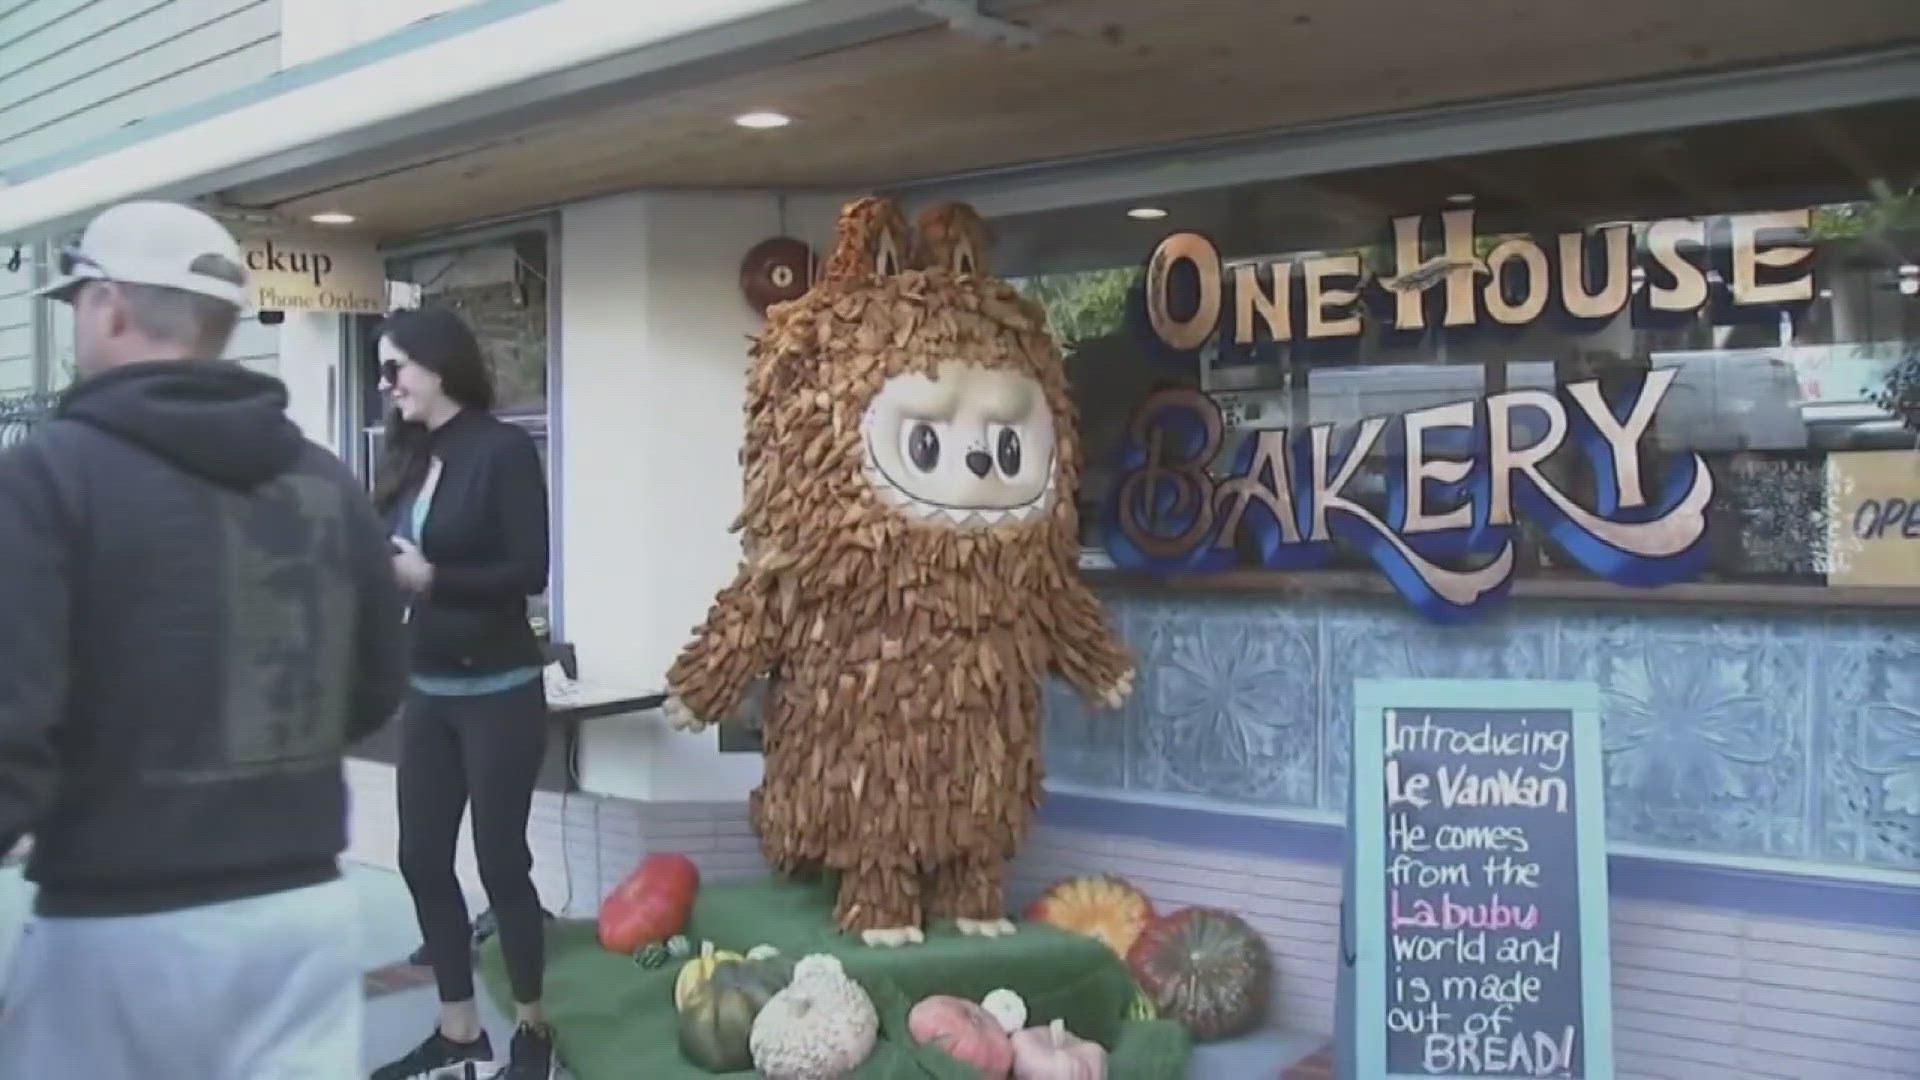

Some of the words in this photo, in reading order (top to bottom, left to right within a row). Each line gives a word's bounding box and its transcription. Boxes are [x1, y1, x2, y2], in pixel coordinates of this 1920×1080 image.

[246, 239, 332, 286] ckup
[1146, 231, 1367, 350] ONE
[1378, 207, 1814, 330] HOUSE
[258, 287, 311, 307] Phone
[319, 292, 379, 309] Orders
[1116, 366, 1714, 608] BAKERY
[1385, 709, 1569, 771] Introducing
[1386, 760, 1431, 809] Le
[1389, 812, 1431, 851] He
[1436, 825, 1529, 852] comes
[1386, 854, 1470, 888] from
[1482, 855, 1541, 888] the
[1391, 888, 1539, 931] Labubu
[1392, 930, 1486, 964] world
[1496, 930, 1560, 970] and
[1395, 965, 1431, 1002] is
[1443, 970, 1541, 1002] made
[1387, 1000, 1451, 1033] out
[1463, 1003, 1515, 1036] of
[1422, 1024, 1576, 1078] BREAD!
